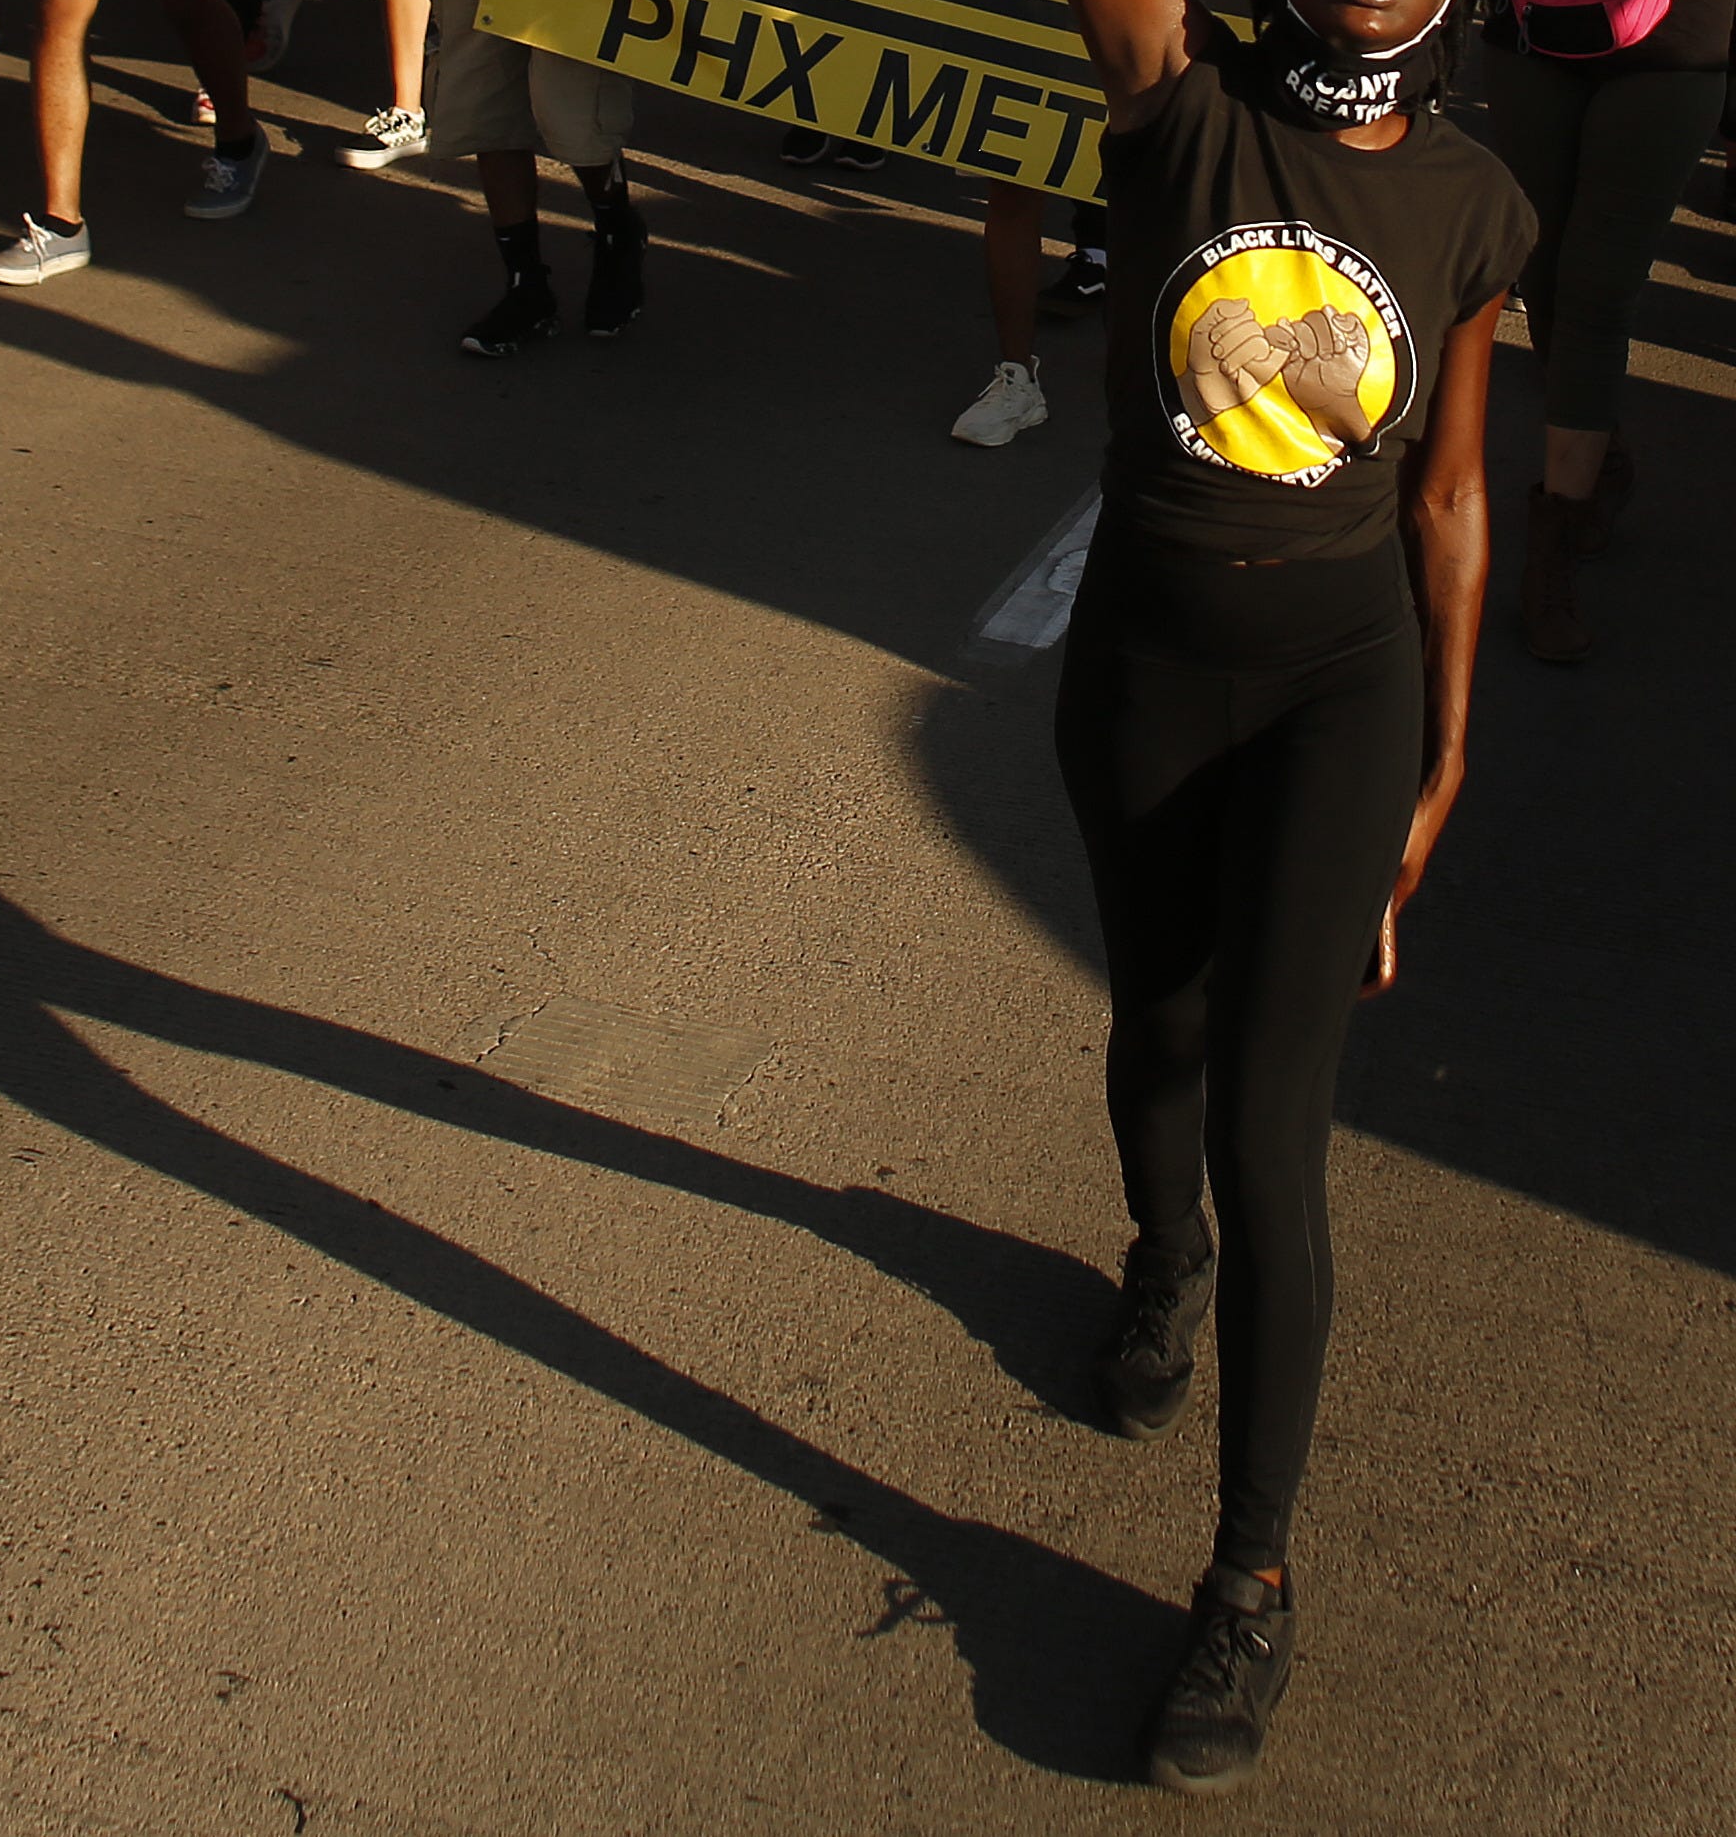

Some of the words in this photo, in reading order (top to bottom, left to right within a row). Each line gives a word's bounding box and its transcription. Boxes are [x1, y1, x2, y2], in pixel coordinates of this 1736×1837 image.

[856, 48, 1110, 200] MET
[1202, 227, 1277, 268] BLACK
[1281, 229, 1337, 264] LIVES
[1337, 258, 1403, 340] MATTER
